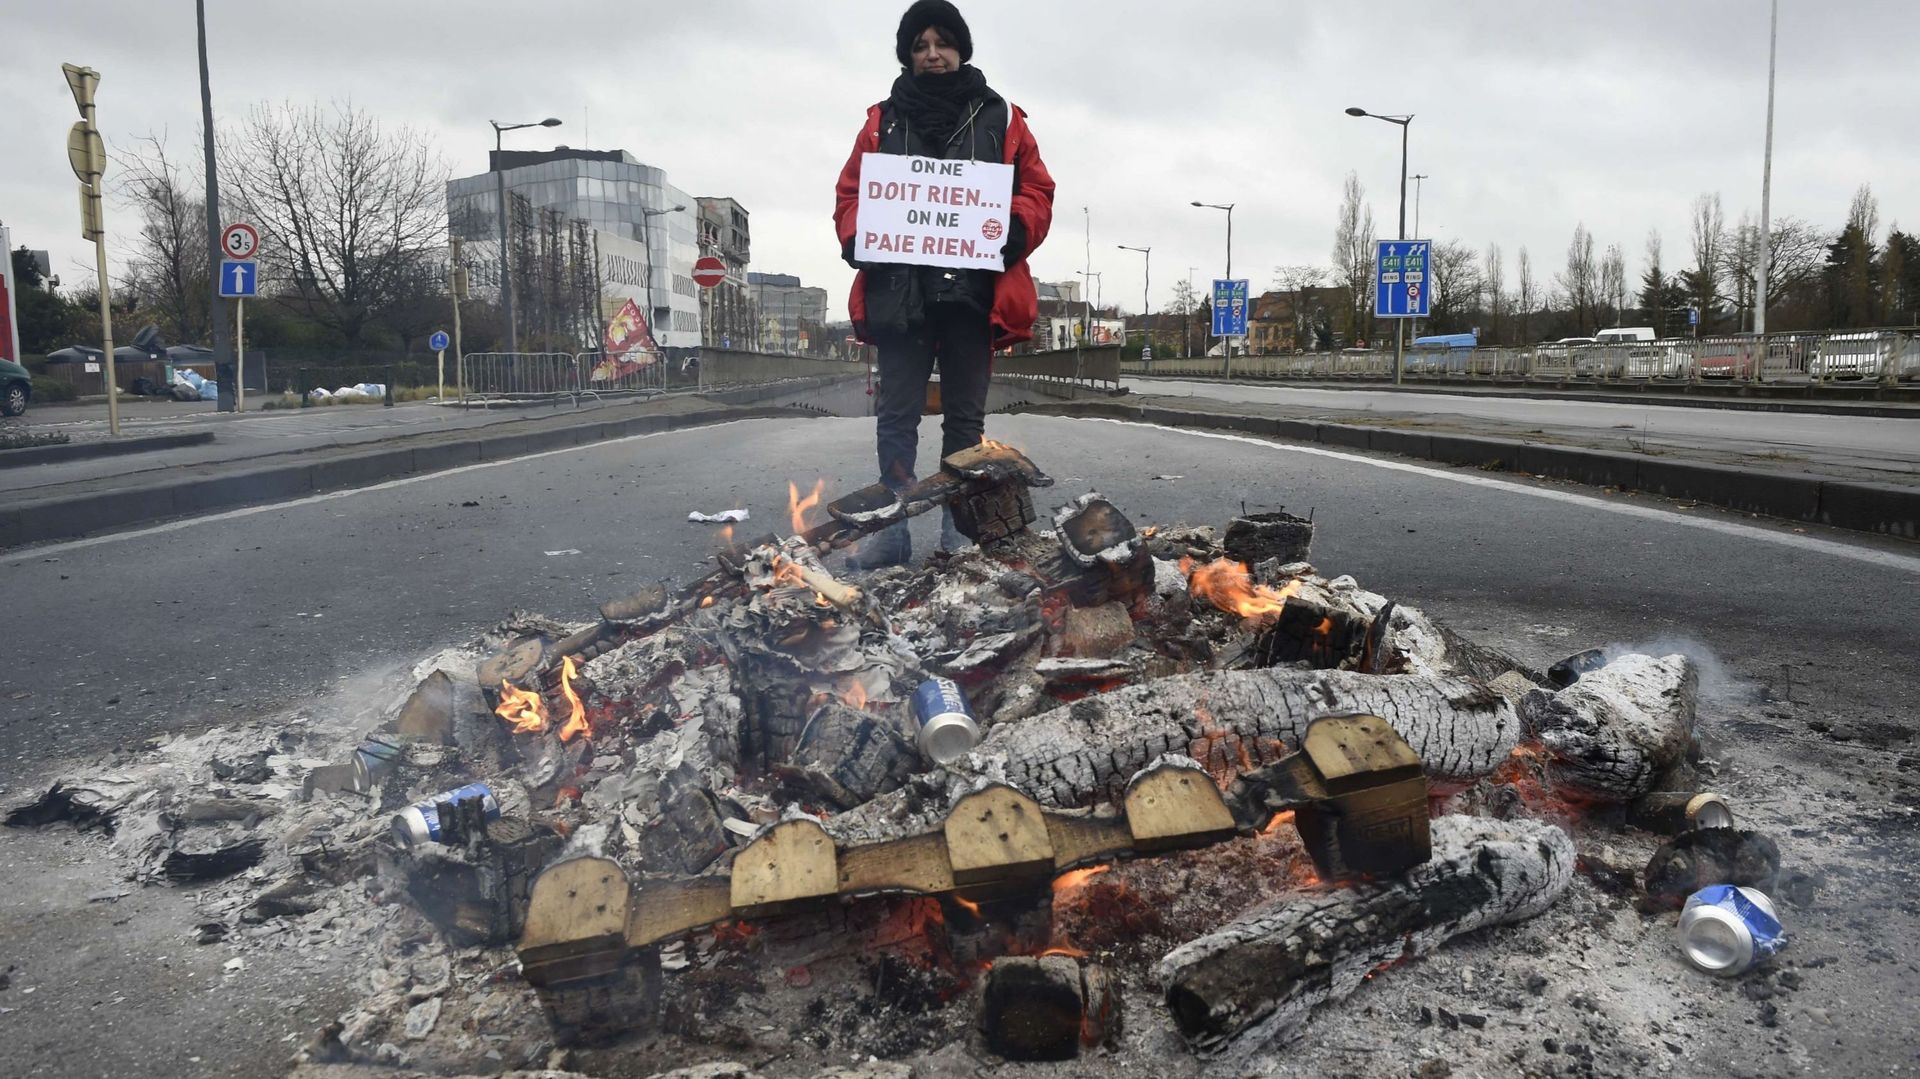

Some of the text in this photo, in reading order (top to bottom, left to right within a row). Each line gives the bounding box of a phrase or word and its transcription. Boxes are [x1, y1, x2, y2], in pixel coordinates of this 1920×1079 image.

[911, 159, 963, 177] ON NE
[868, 181, 1002, 208] DOIT RIEN...
[906, 209, 960, 227] ON NE
[864, 232, 996, 259] PAIE RIEN...
[1383, 258, 1399, 267] E411
[1405, 257, 1422, 267] E411
